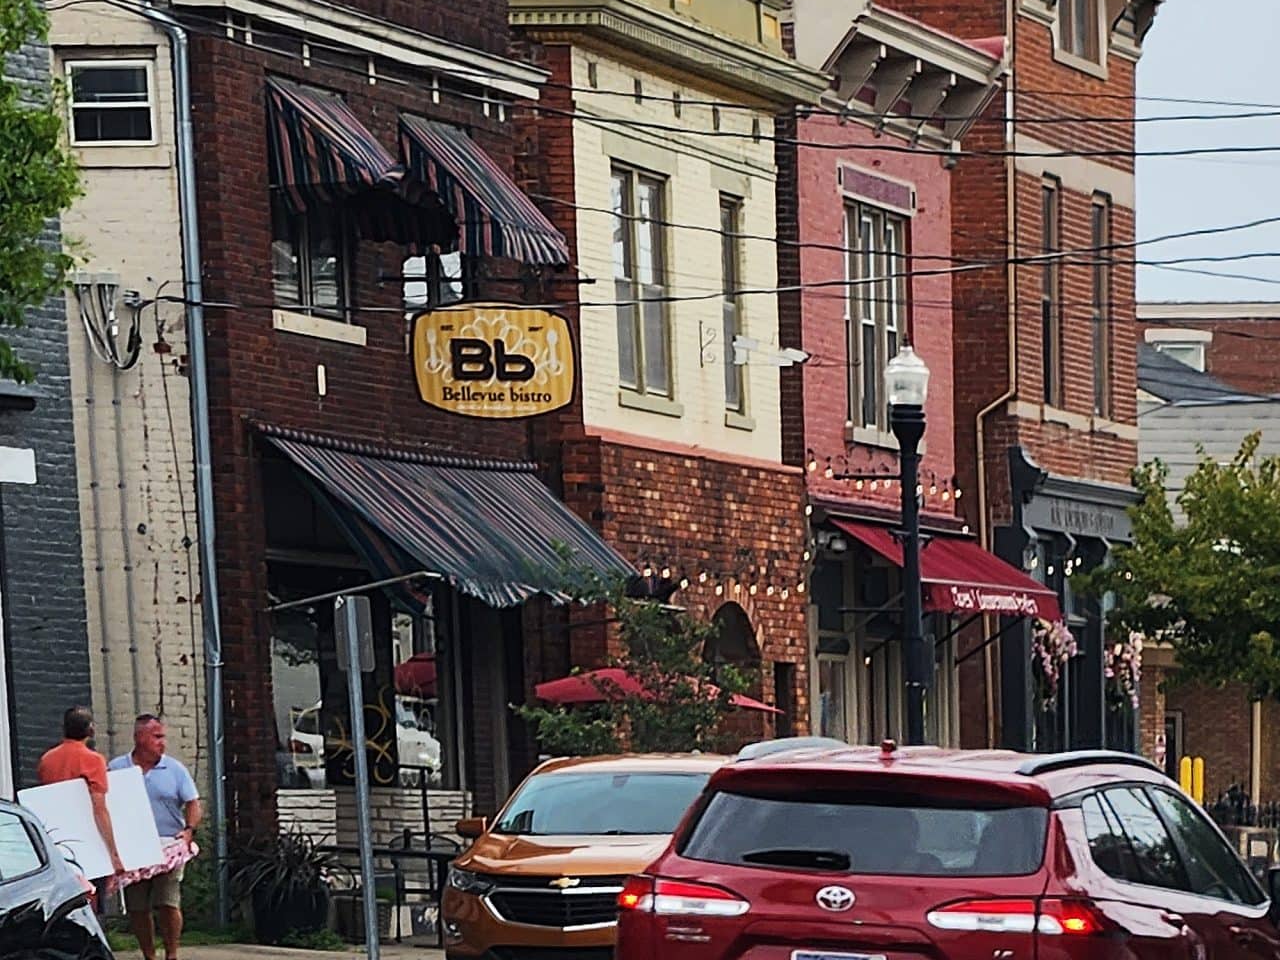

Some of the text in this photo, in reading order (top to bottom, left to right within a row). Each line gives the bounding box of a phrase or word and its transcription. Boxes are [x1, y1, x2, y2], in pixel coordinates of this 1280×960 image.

[450, 338, 536, 381] Bb
[442, 387, 552, 403] Bellevue bistro
